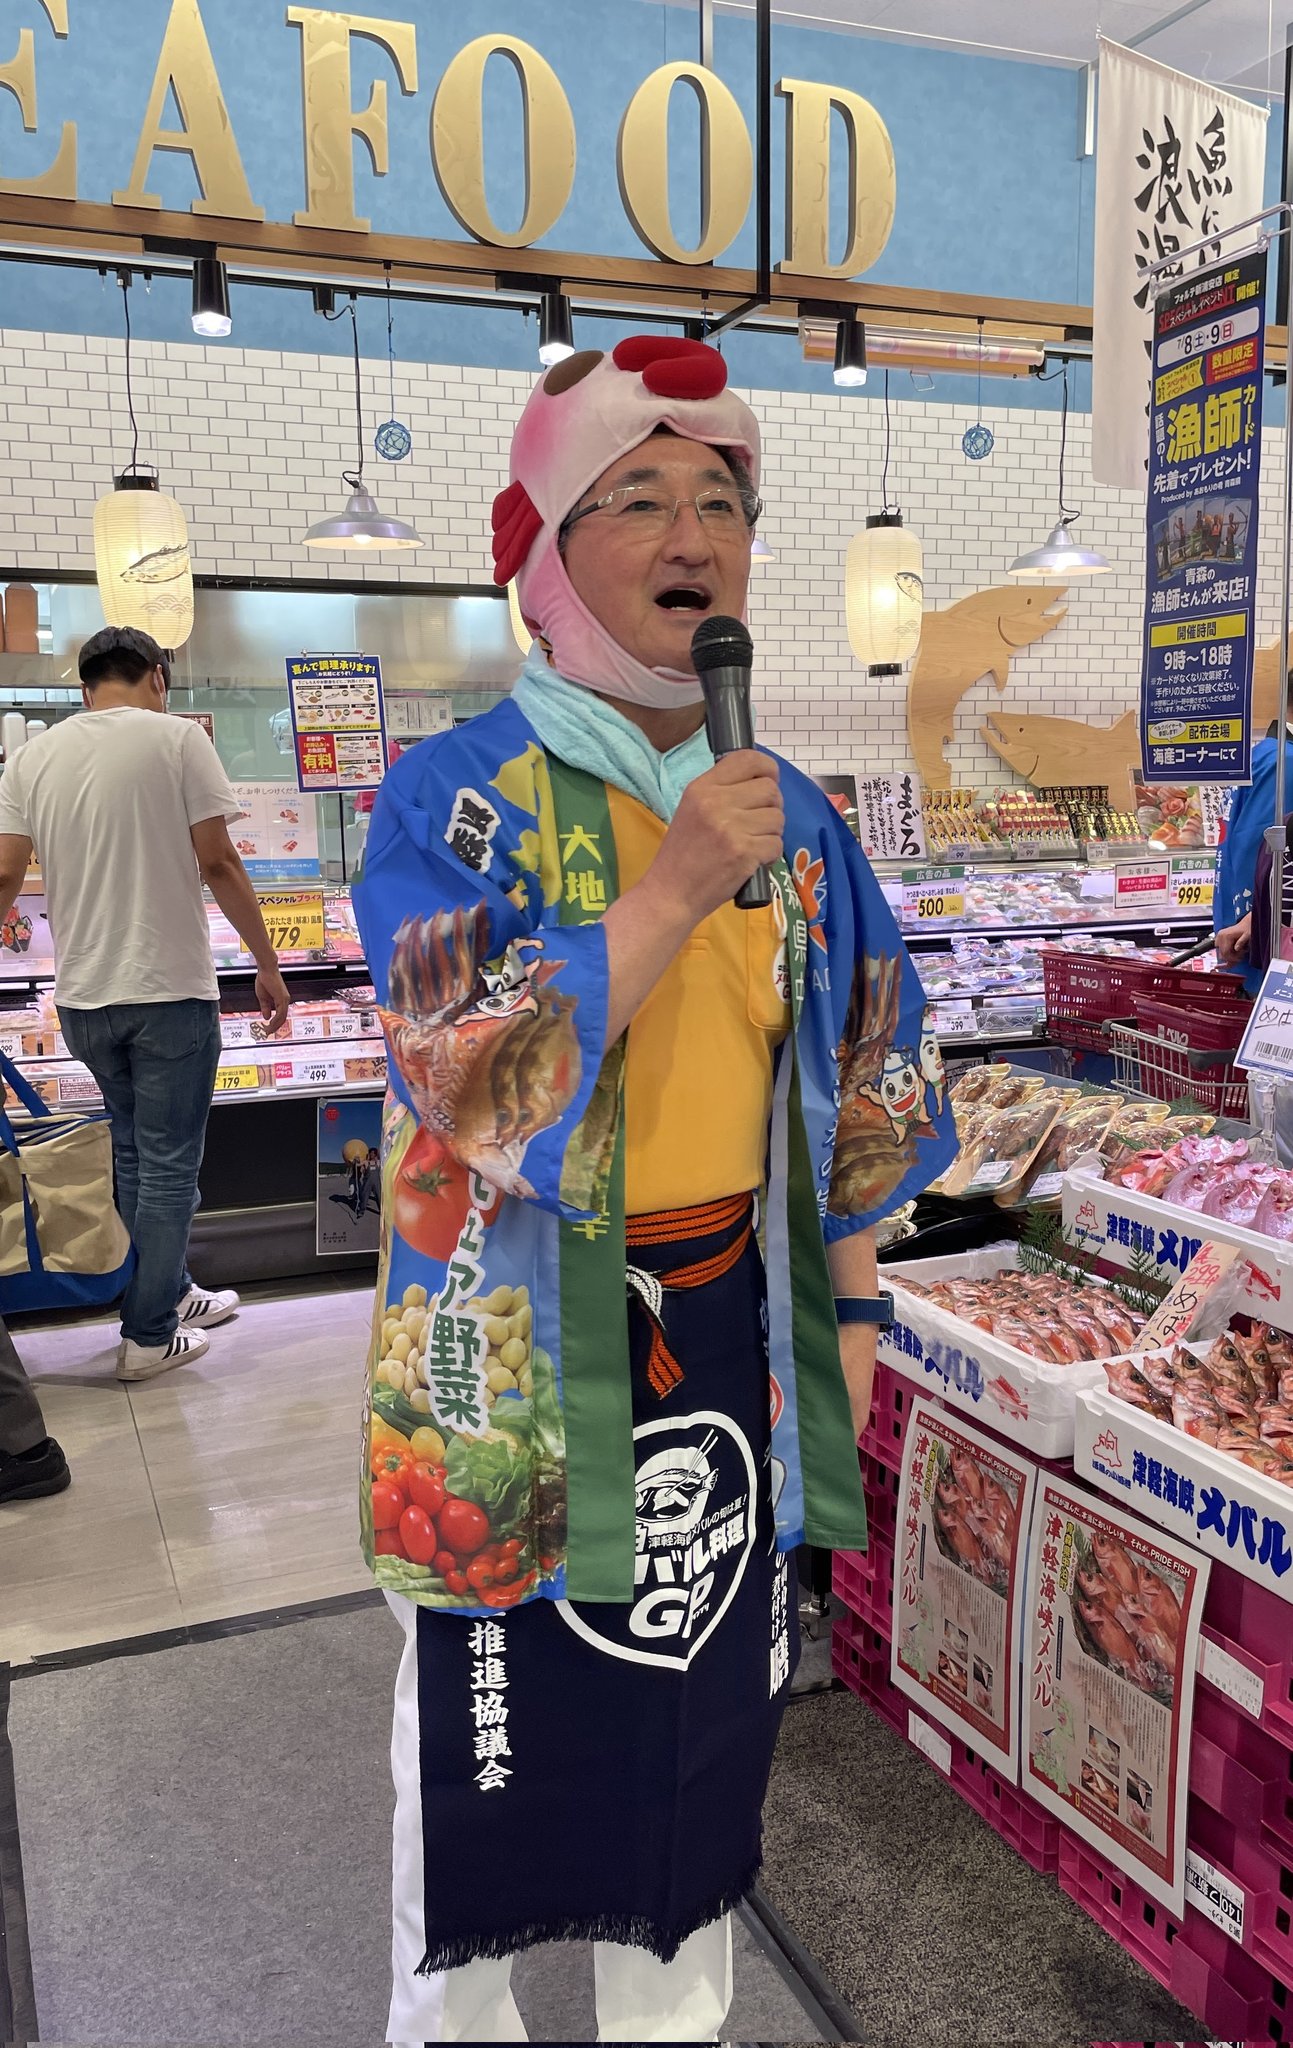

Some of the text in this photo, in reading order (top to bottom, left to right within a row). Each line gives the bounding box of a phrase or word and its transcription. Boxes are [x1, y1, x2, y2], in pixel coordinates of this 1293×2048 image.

[1224, 269, 1240, 284] 限定
[1236, 280, 1260, 302] 開催!
[1211, 342, 1254, 369] 数量限定
[1243, 384, 1256, 444] カード
[1166, 388, 1243, 464] 漁師
[1153, 449, 1252, 495] 先着でプレゼント!
[1161, 491, 1185, 504] Produced
[1185, 566, 1216, 586] 青森の
[1151, 576, 1250, 614] 漁師さんが来店!
[1177, 622, 1217, 641] 開催時間
[291, 660, 376, 675] 喜んで調理承ります!
[1156, 682, 1240, 698] 手作りのためご容赦ください。
[1189, 723, 1230, 740] 配布会場
[303, 753, 333, 769] 有料
[1153, 747, 1237, 766] 海産コーナーにて
[897, 775, 921, 856] まぐろ
[1128, 867, 1158, 875] お客様へ
[1178, 860, 1210, 869] 広告の品
[916, 868, 951, 881] 広告の品
[1178, 886, 1201, 904] 999
[918, 898, 944, 917] 500
[1078, 977, 1099, 989] ベルク
[1166, 1027, 1190, 1047] ベルク
[222, 1076, 240, 1088] 179
[309, 1070, 327, 1081] 499
[902, 1432, 931, 1607] 津軽海峡メバル
[1150, 1549, 1173, 1567] PRIDE
[1173, 1560, 1191, 1578] FISH
[1033, 1512, 1063, 1708] 津軽海峡メバル
